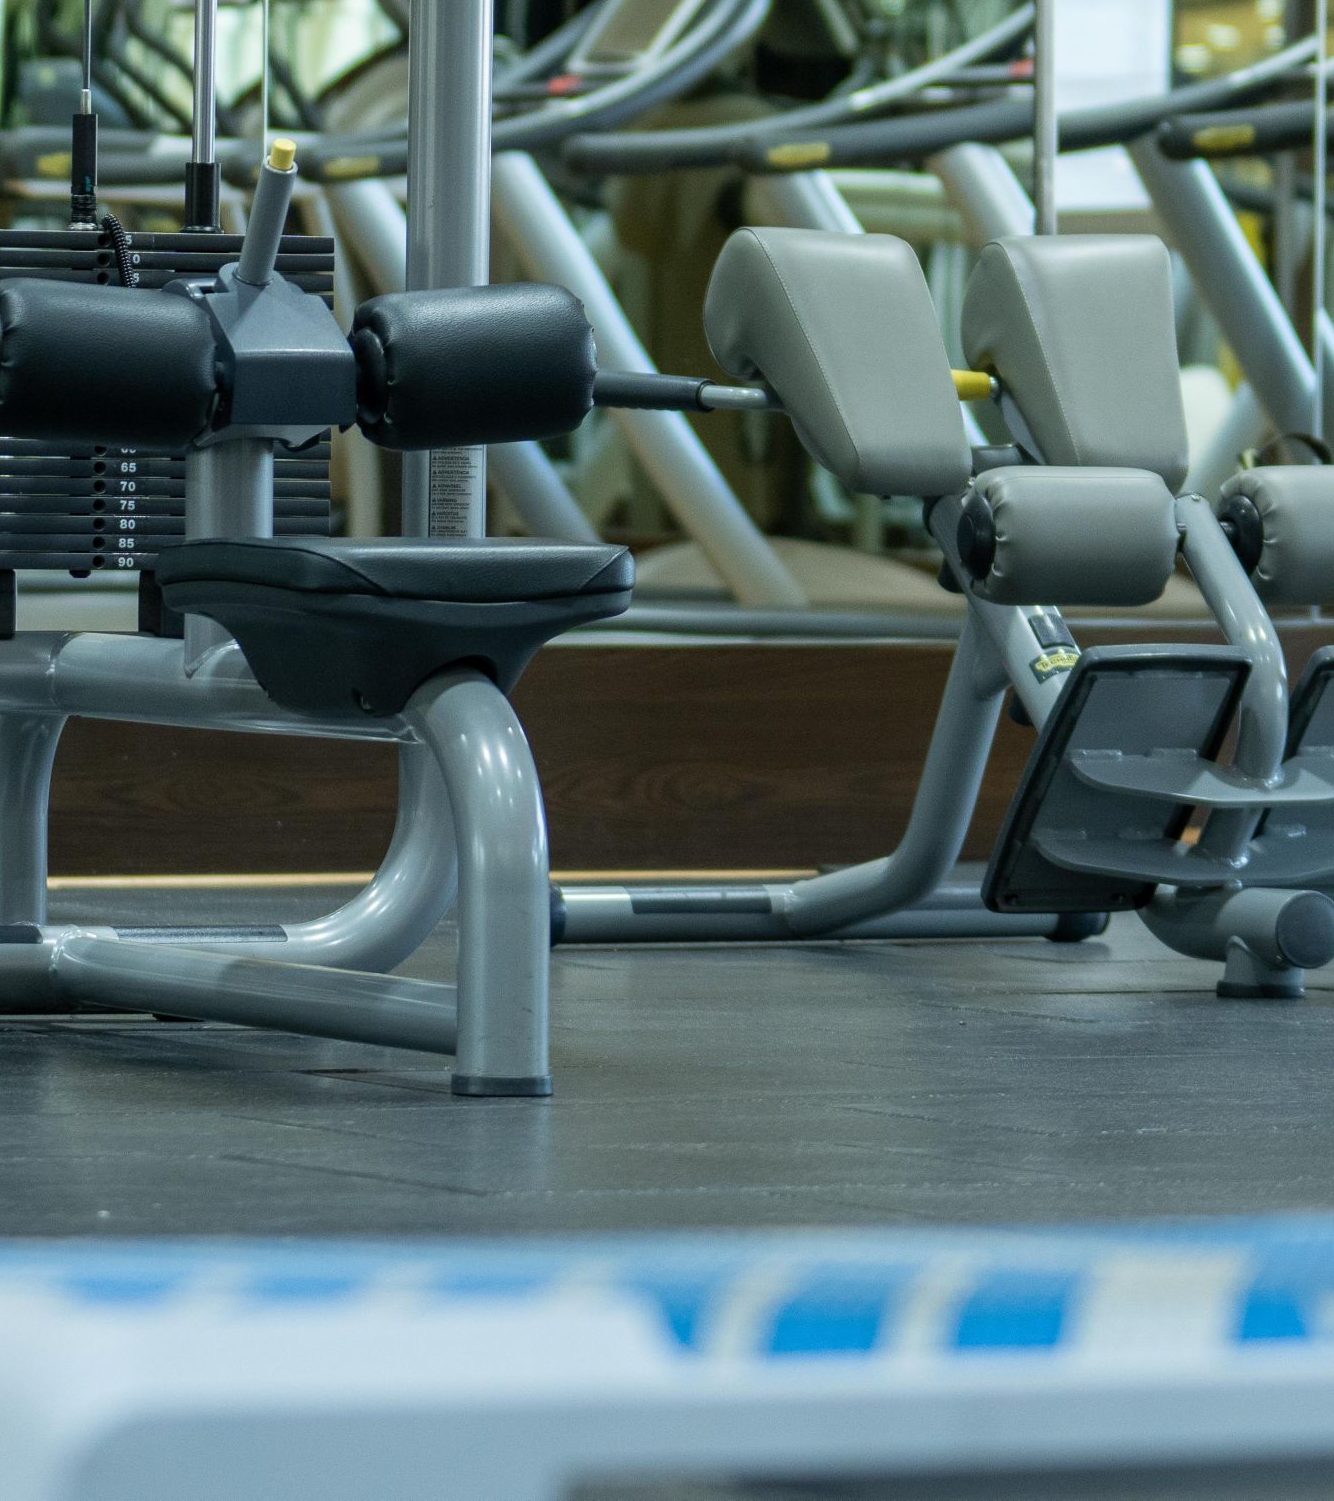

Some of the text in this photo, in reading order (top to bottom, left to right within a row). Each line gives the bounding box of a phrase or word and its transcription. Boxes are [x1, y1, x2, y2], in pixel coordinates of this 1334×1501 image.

[120, 462, 137, 473] 65
[119, 481, 136, 492] 70
[119, 500, 136, 511] 75
[119, 519, 136, 529] 80
[118, 538, 135, 548] 85
[118, 557, 134, 567] 90
